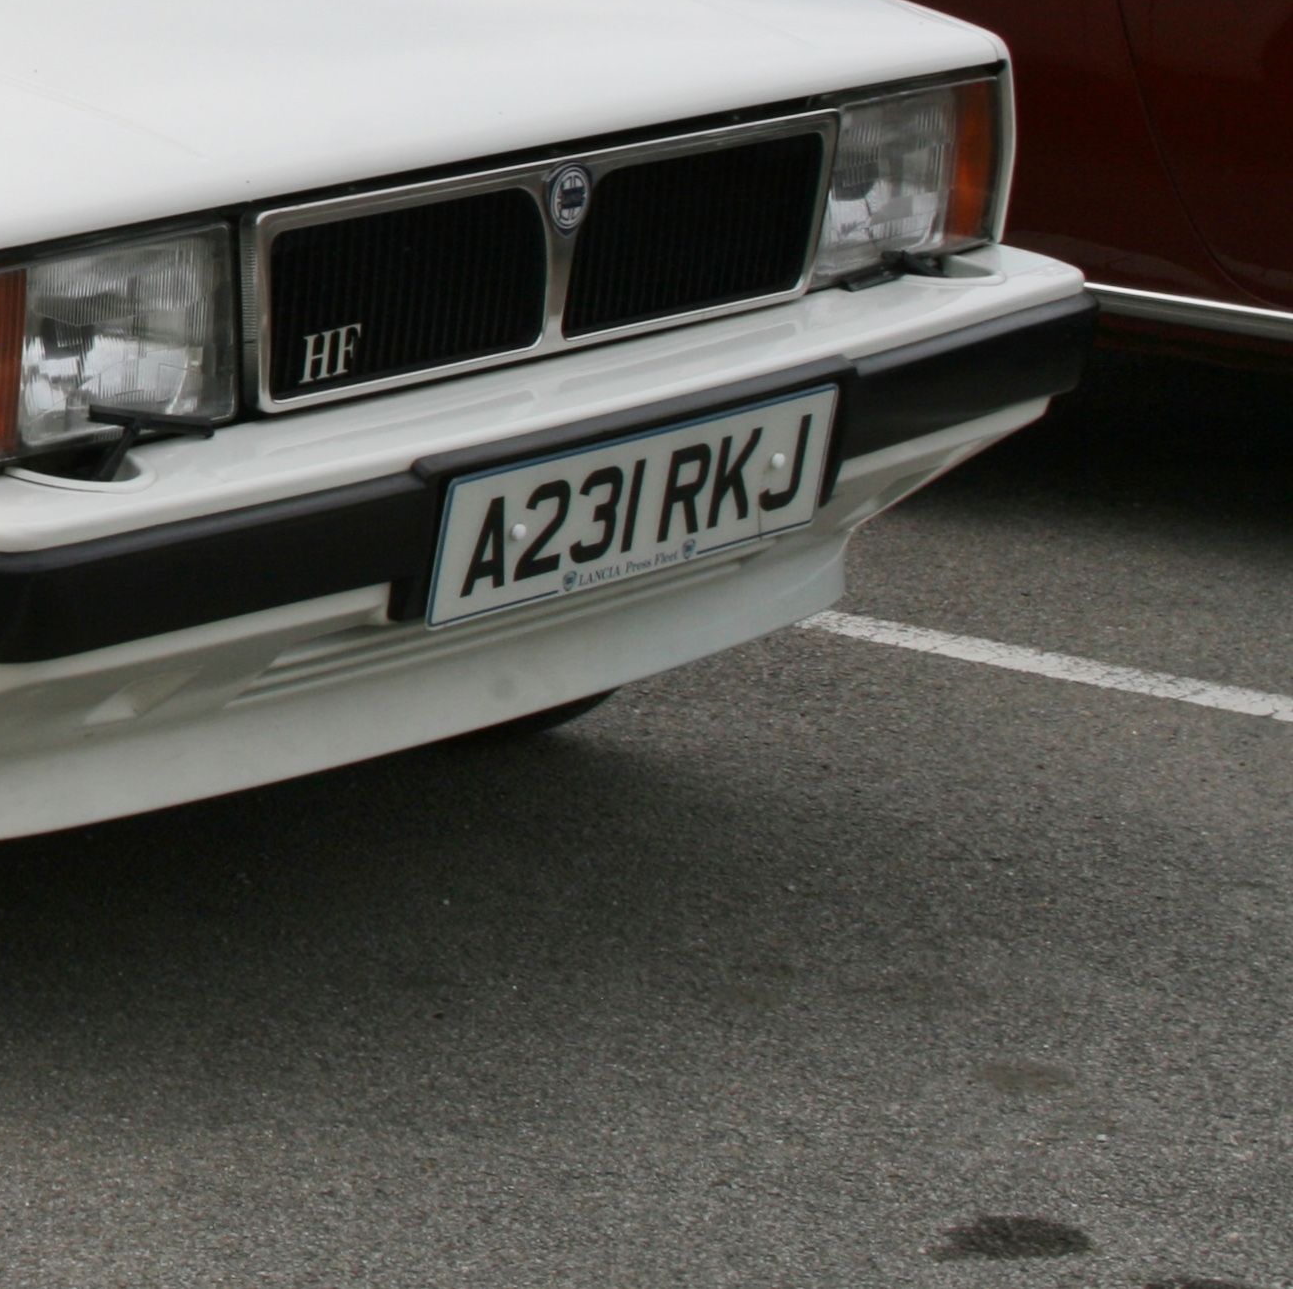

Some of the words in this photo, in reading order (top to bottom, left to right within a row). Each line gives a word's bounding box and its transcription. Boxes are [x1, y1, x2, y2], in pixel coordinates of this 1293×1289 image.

[298, 322, 362, 384] HF
[460, 458, 647, 599] A231
[657, 414, 813, 544] RKJ
[578, 566, 621, 587] LANCIA
[625, 559, 652, 574] Press
[654, 551, 679, 566] Fleet
